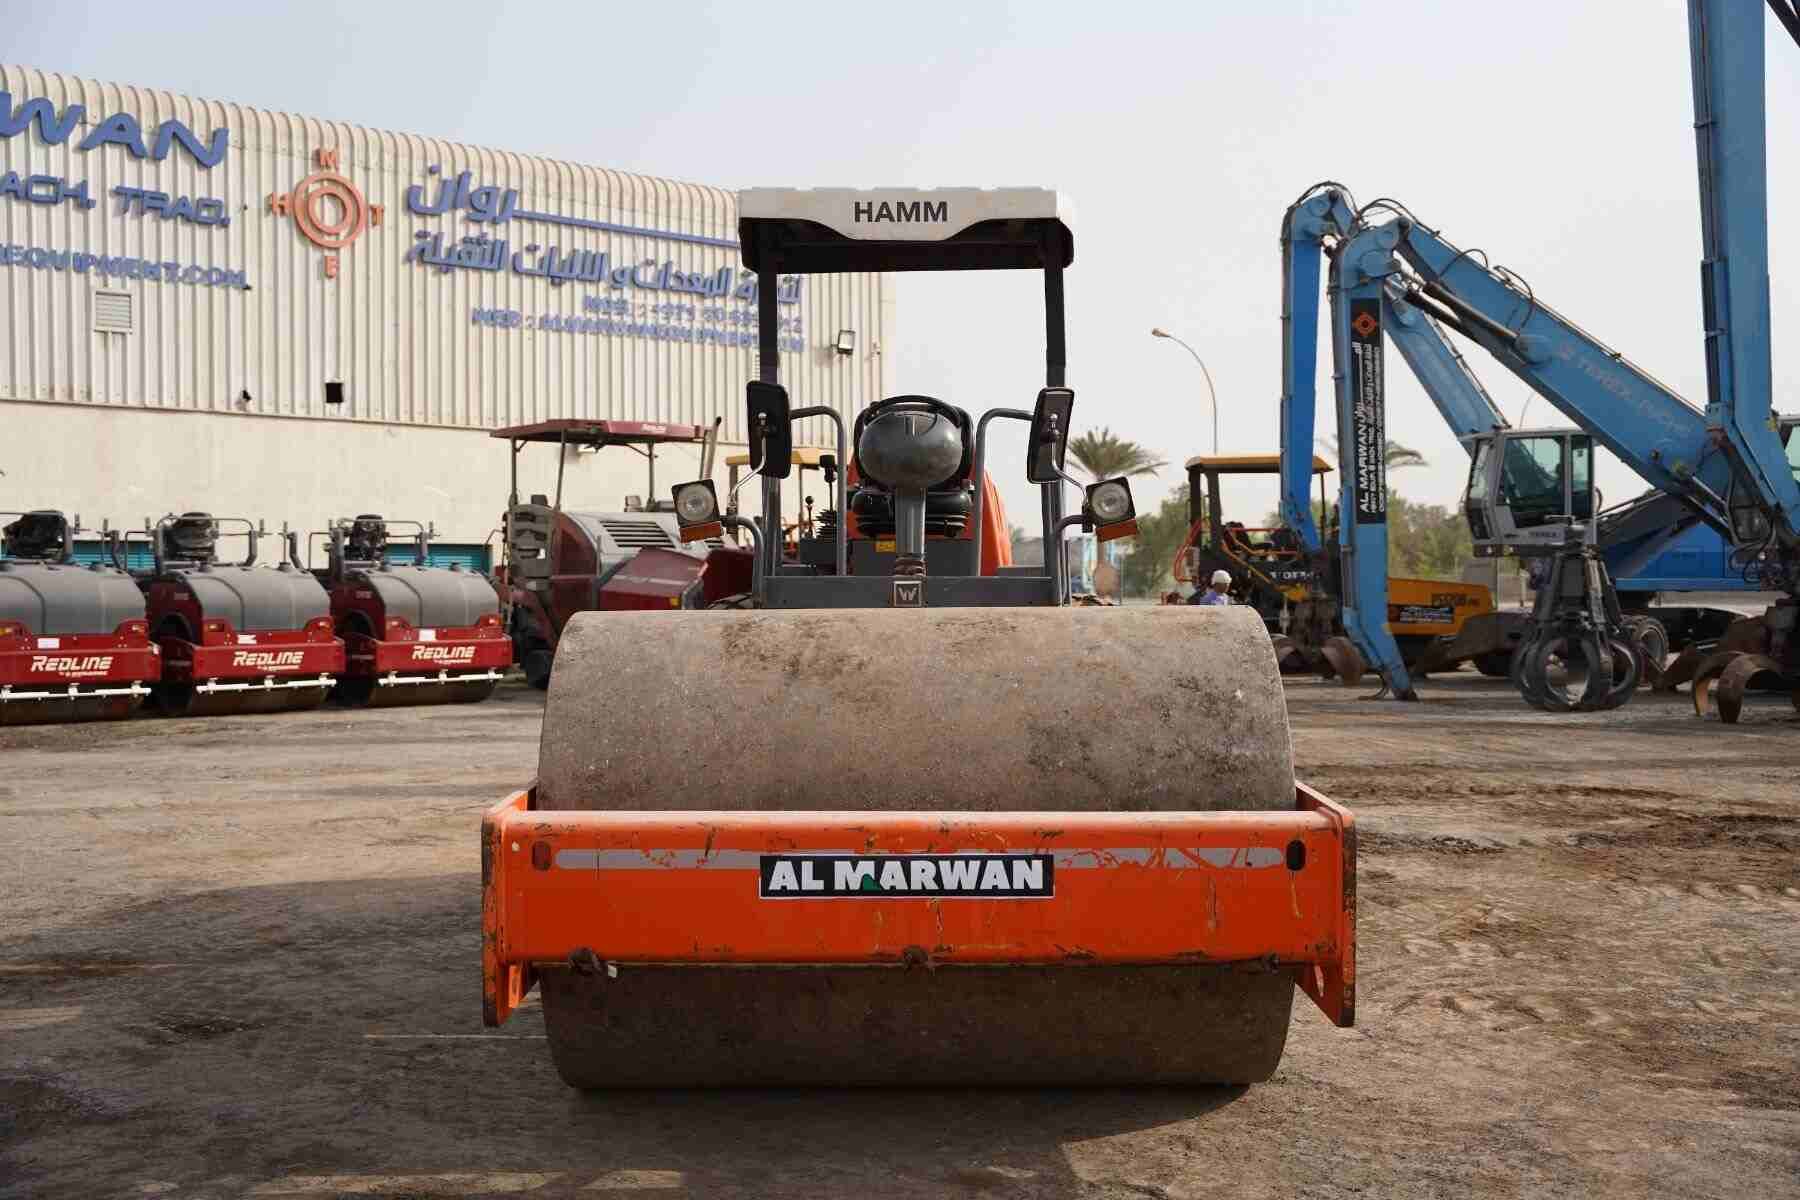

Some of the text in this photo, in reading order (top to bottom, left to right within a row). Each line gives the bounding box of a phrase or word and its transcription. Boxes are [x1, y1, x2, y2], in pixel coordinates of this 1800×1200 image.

[854, 200, 948, 222] HAMM
[233, 651, 304, 667] REDLINE
[412, 645, 476, 660] REDLINE
[30, 655, 114, 672] REDLINE
[768, 859, 1043, 891] AL MARWAN
